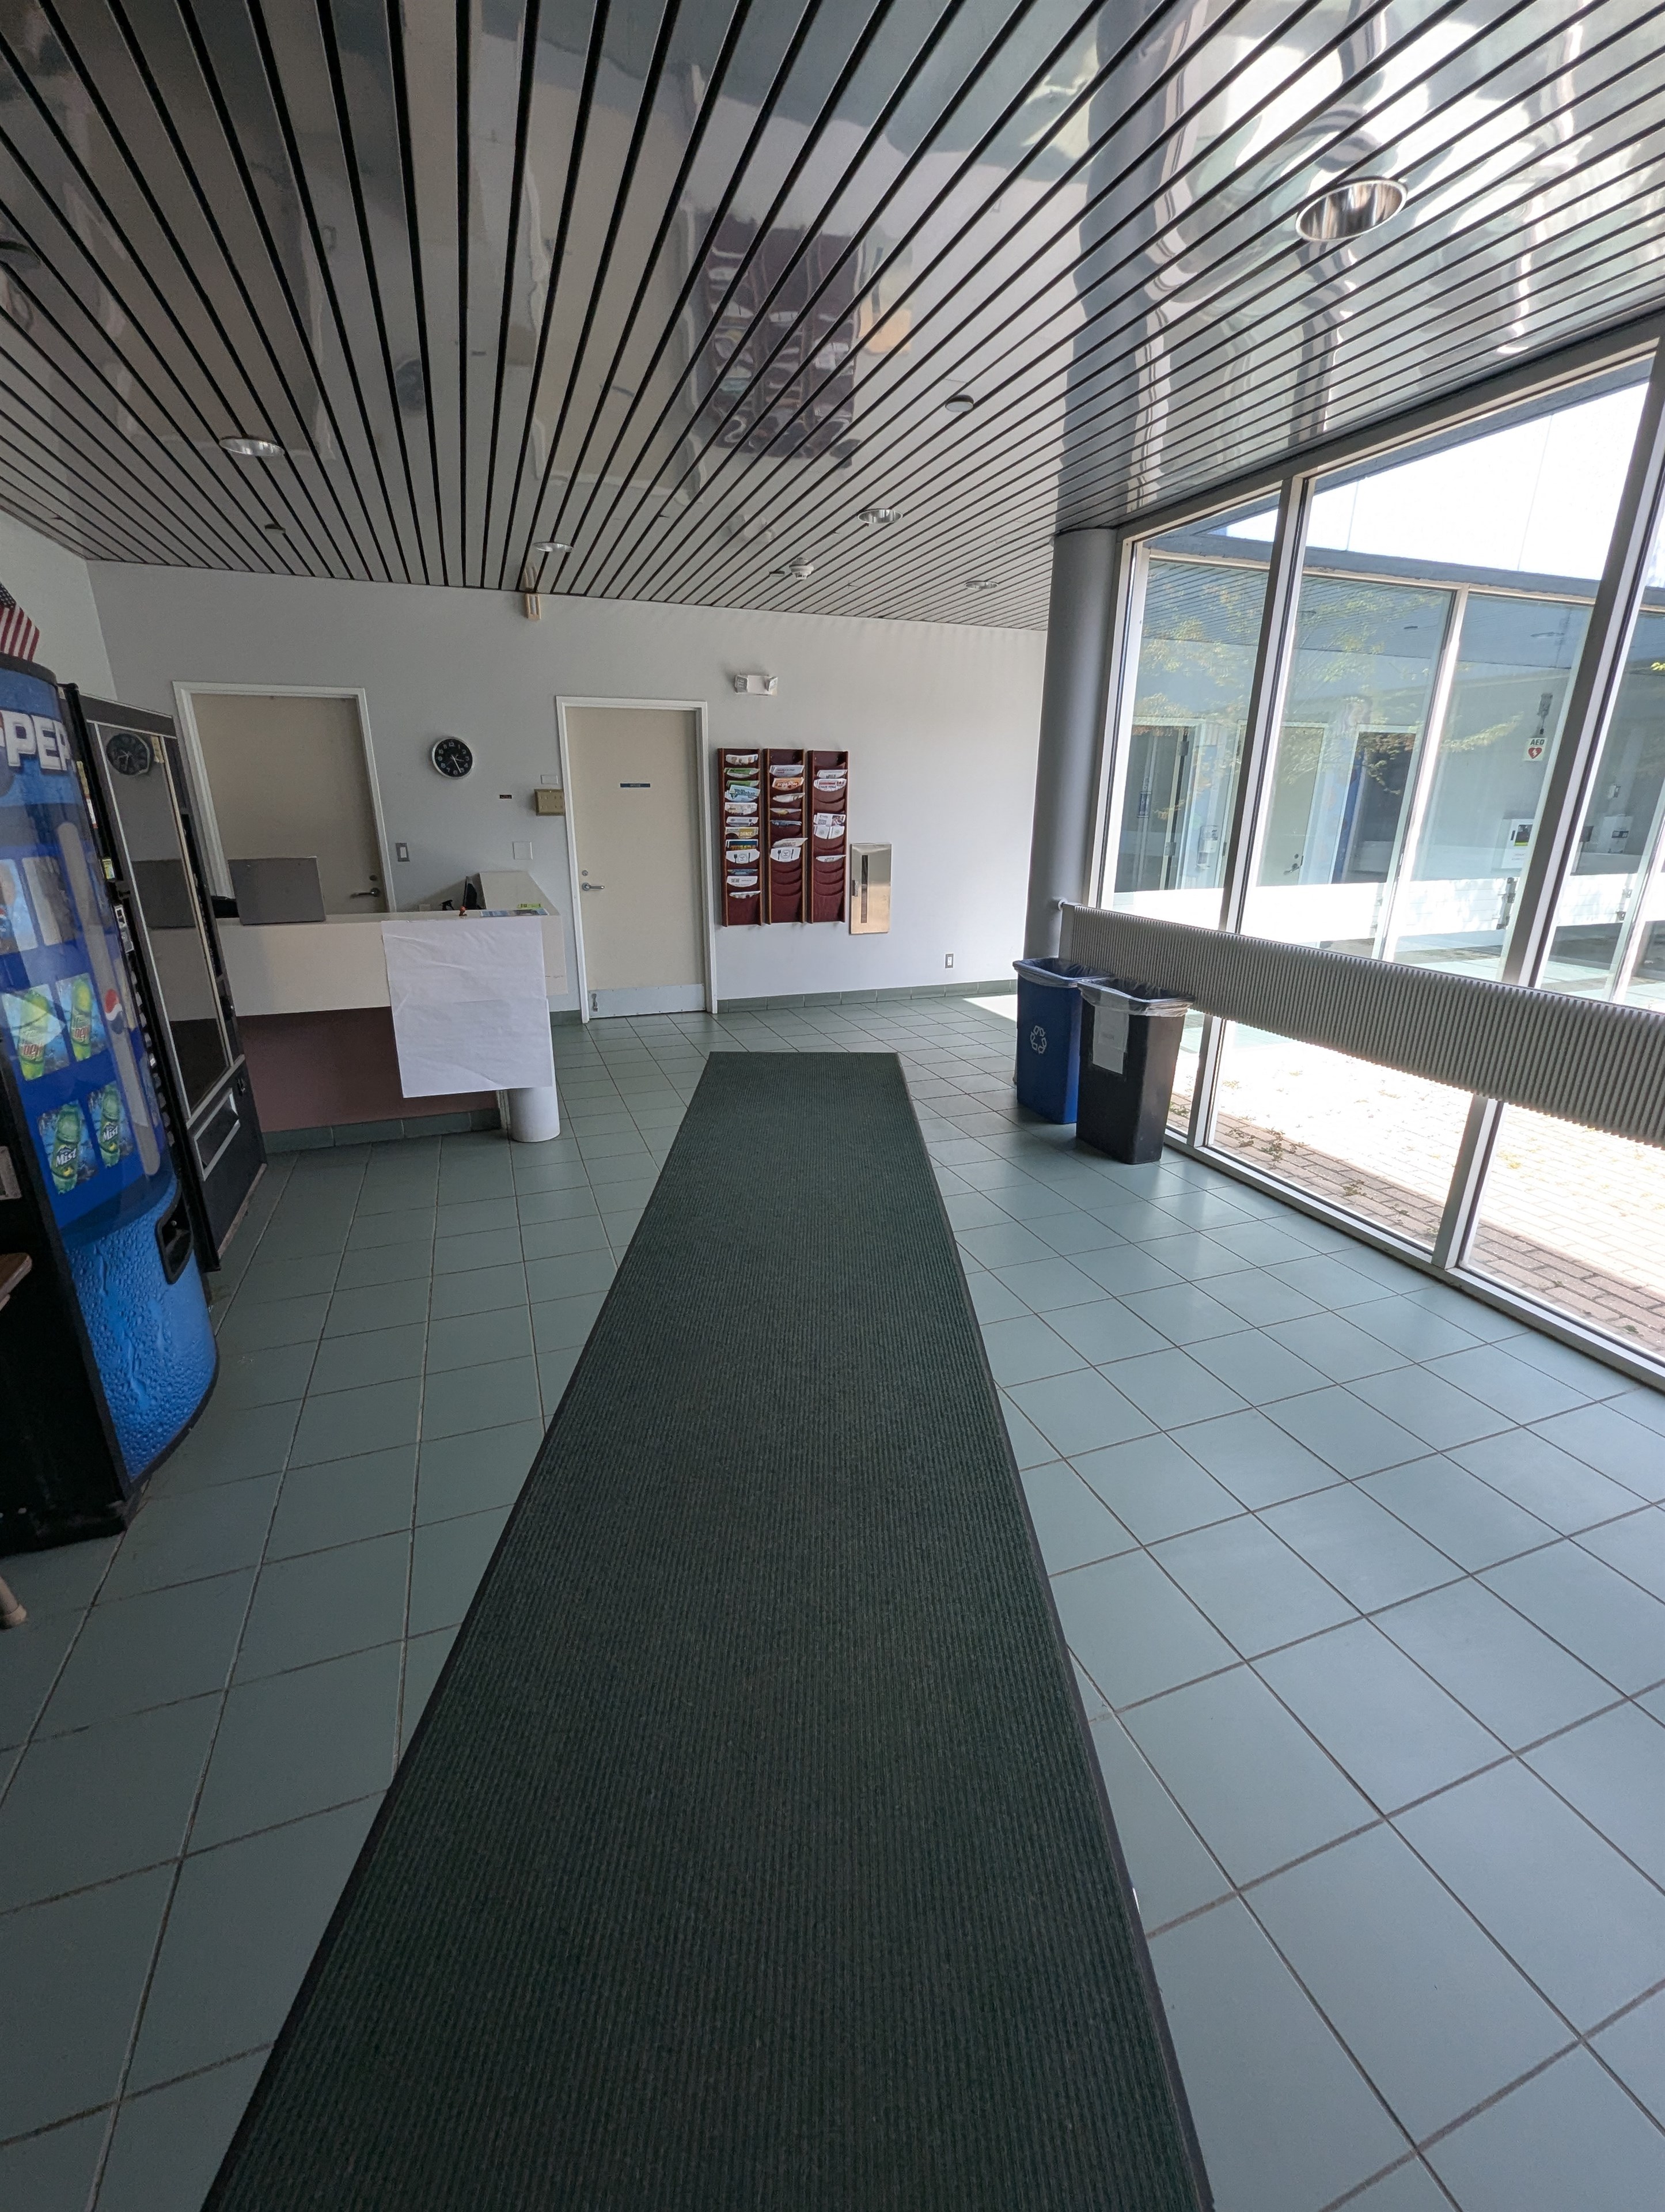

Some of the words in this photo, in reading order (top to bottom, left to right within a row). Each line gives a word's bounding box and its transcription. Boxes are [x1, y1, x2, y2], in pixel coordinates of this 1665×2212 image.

[1, 710, 76, 772] PEP
[103, 1125, 118, 1142] Mist
[56, 1148, 77, 1168] Mist
